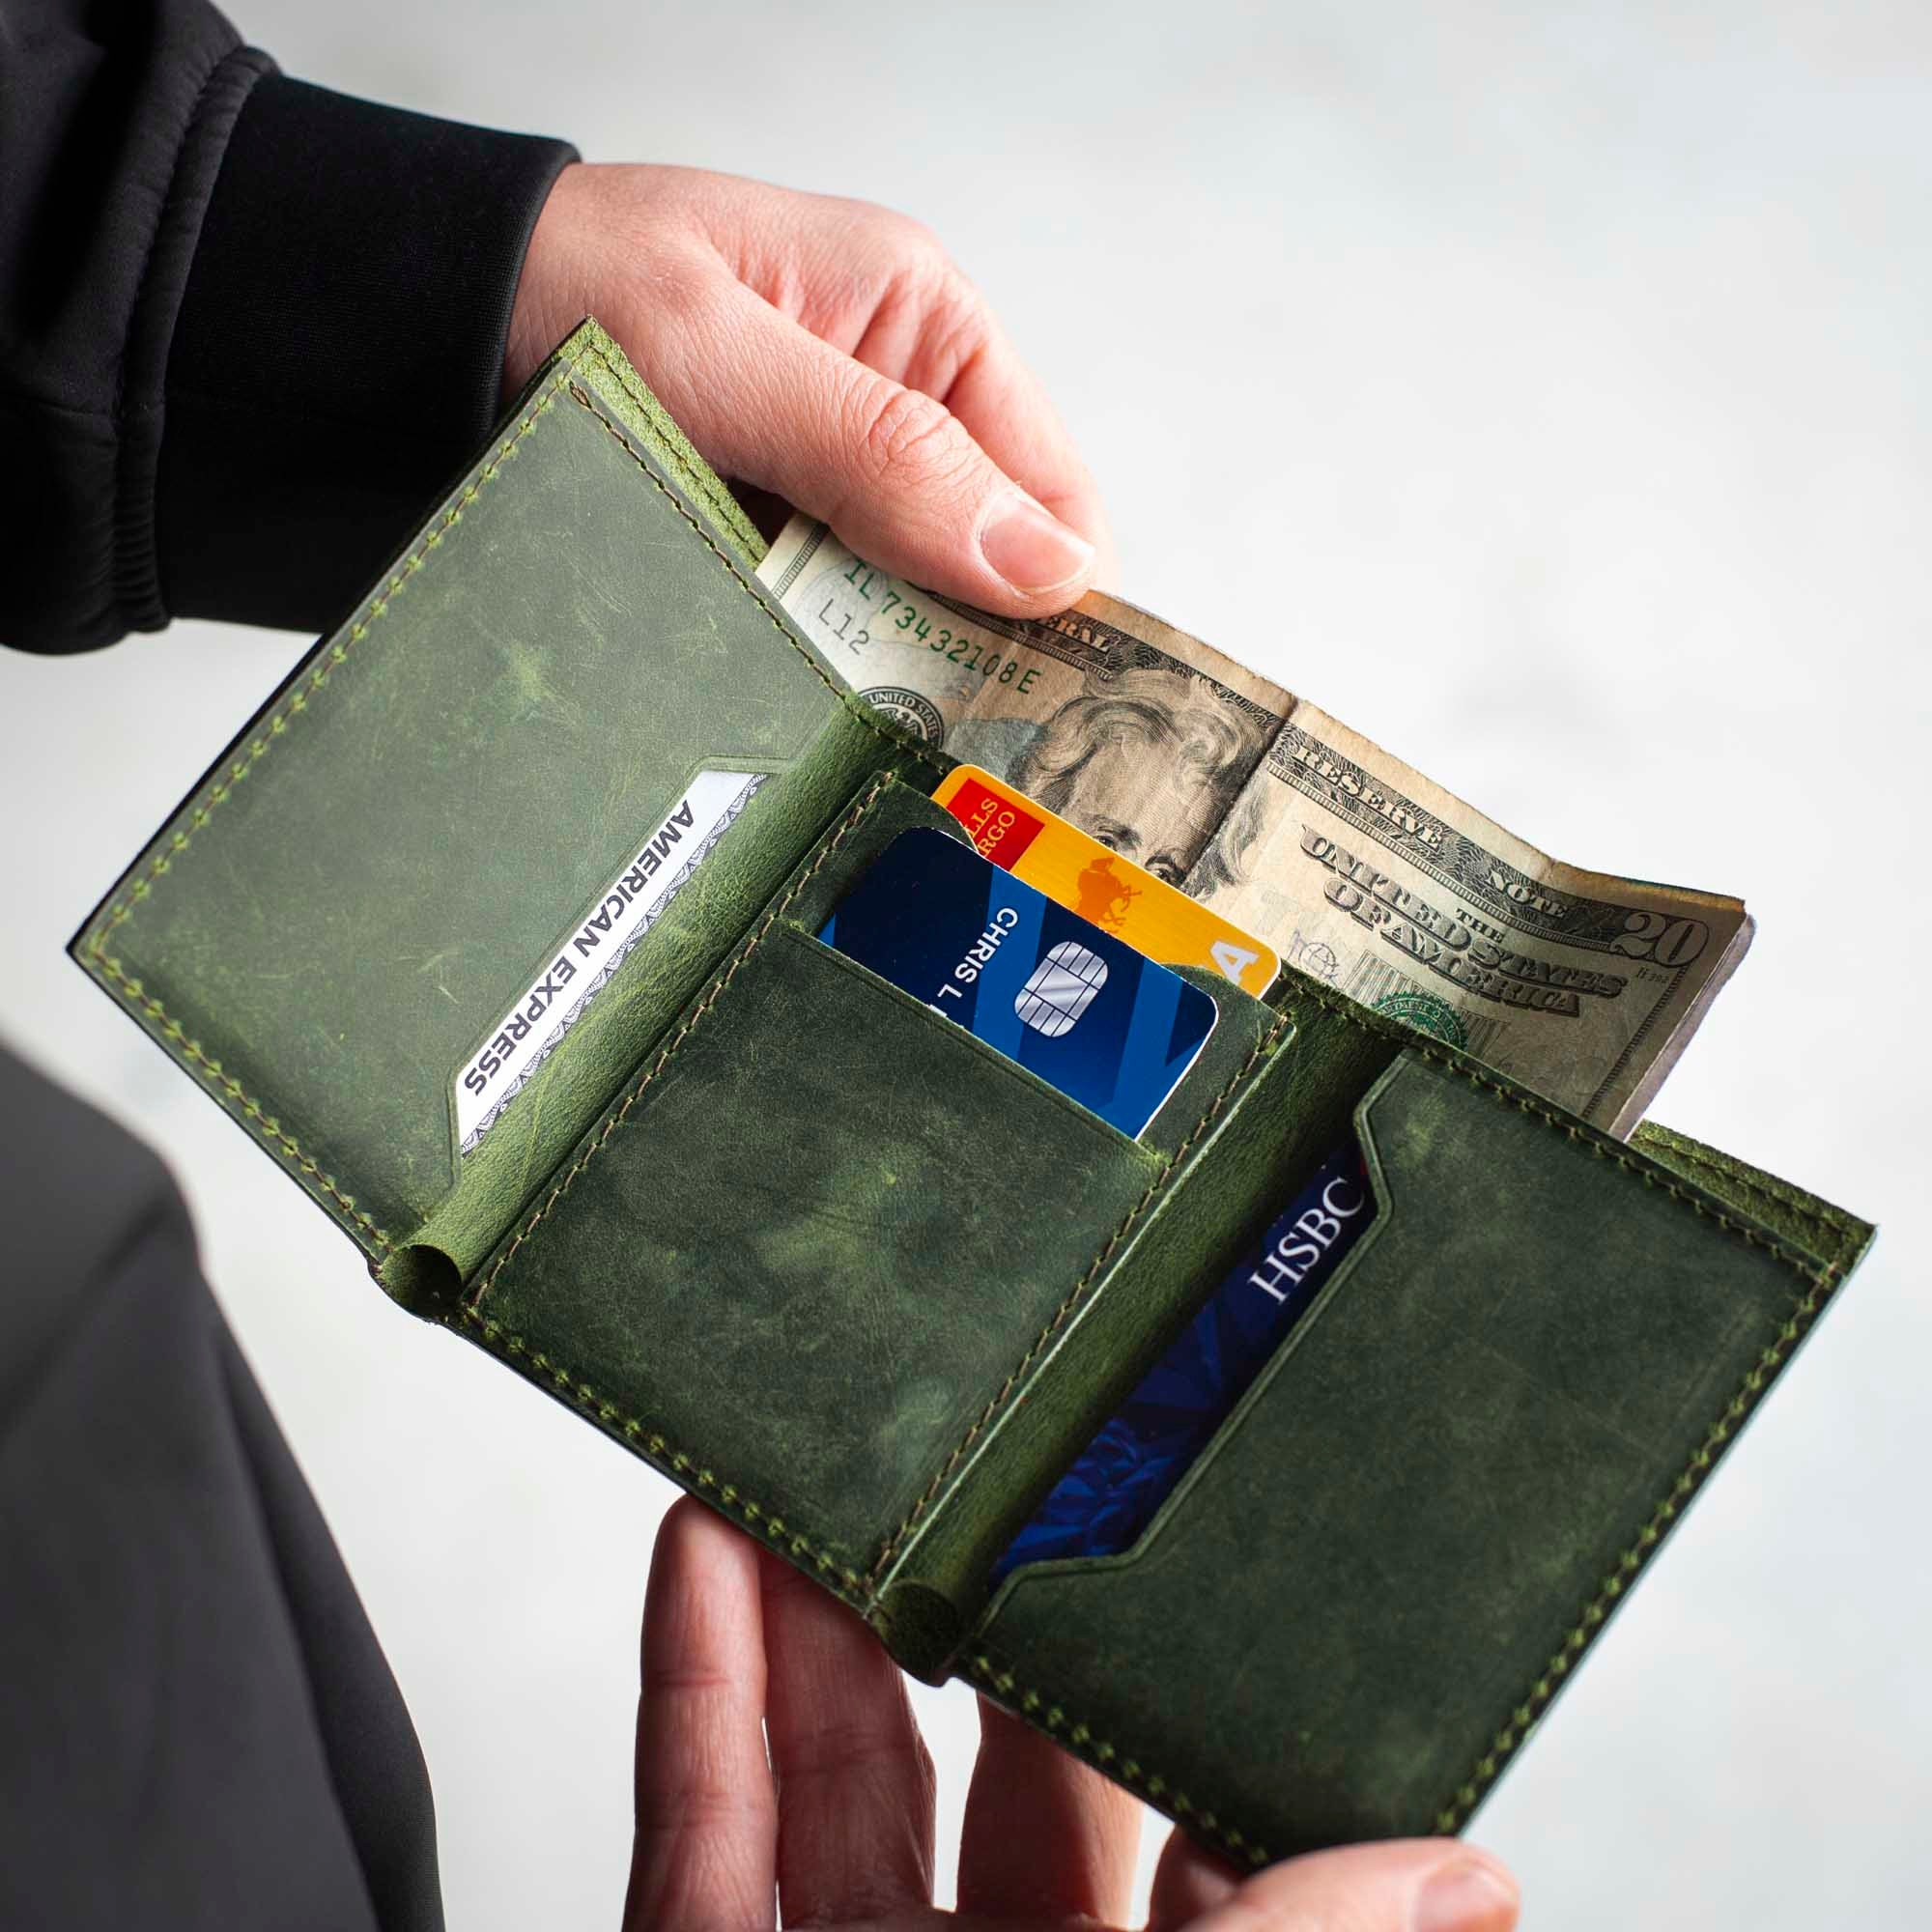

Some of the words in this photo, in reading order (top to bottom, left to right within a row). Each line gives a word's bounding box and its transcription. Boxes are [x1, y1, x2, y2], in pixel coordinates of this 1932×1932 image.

[818, 598, 869, 656] L12
[869, 692, 915, 707] UNITED
[963, 798, 999, 838] LLS
[977, 810, 1015, 858] RGO
[1291, 745, 1443, 855] RESERVE
[1485, 870, 1568, 919] NOTE
[573, 799, 696, 958] AMERICAN
[1299, 823, 1473, 952] UNITED
[1467, 936, 1629, 999] STATES
[954, 907, 1018, 983] CHRIS
[1323, 876, 1392, 932] OF
[1379, 922, 1580, 1018] AMERICA
[1455, 907, 1506, 944] THE
[1609, 910, 1710, 969] 20
[937, 983, 963, 998] L
[464, 955, 579, 1096] EXPRESS
[1246, 1176, 1366, 1305] HSBC
